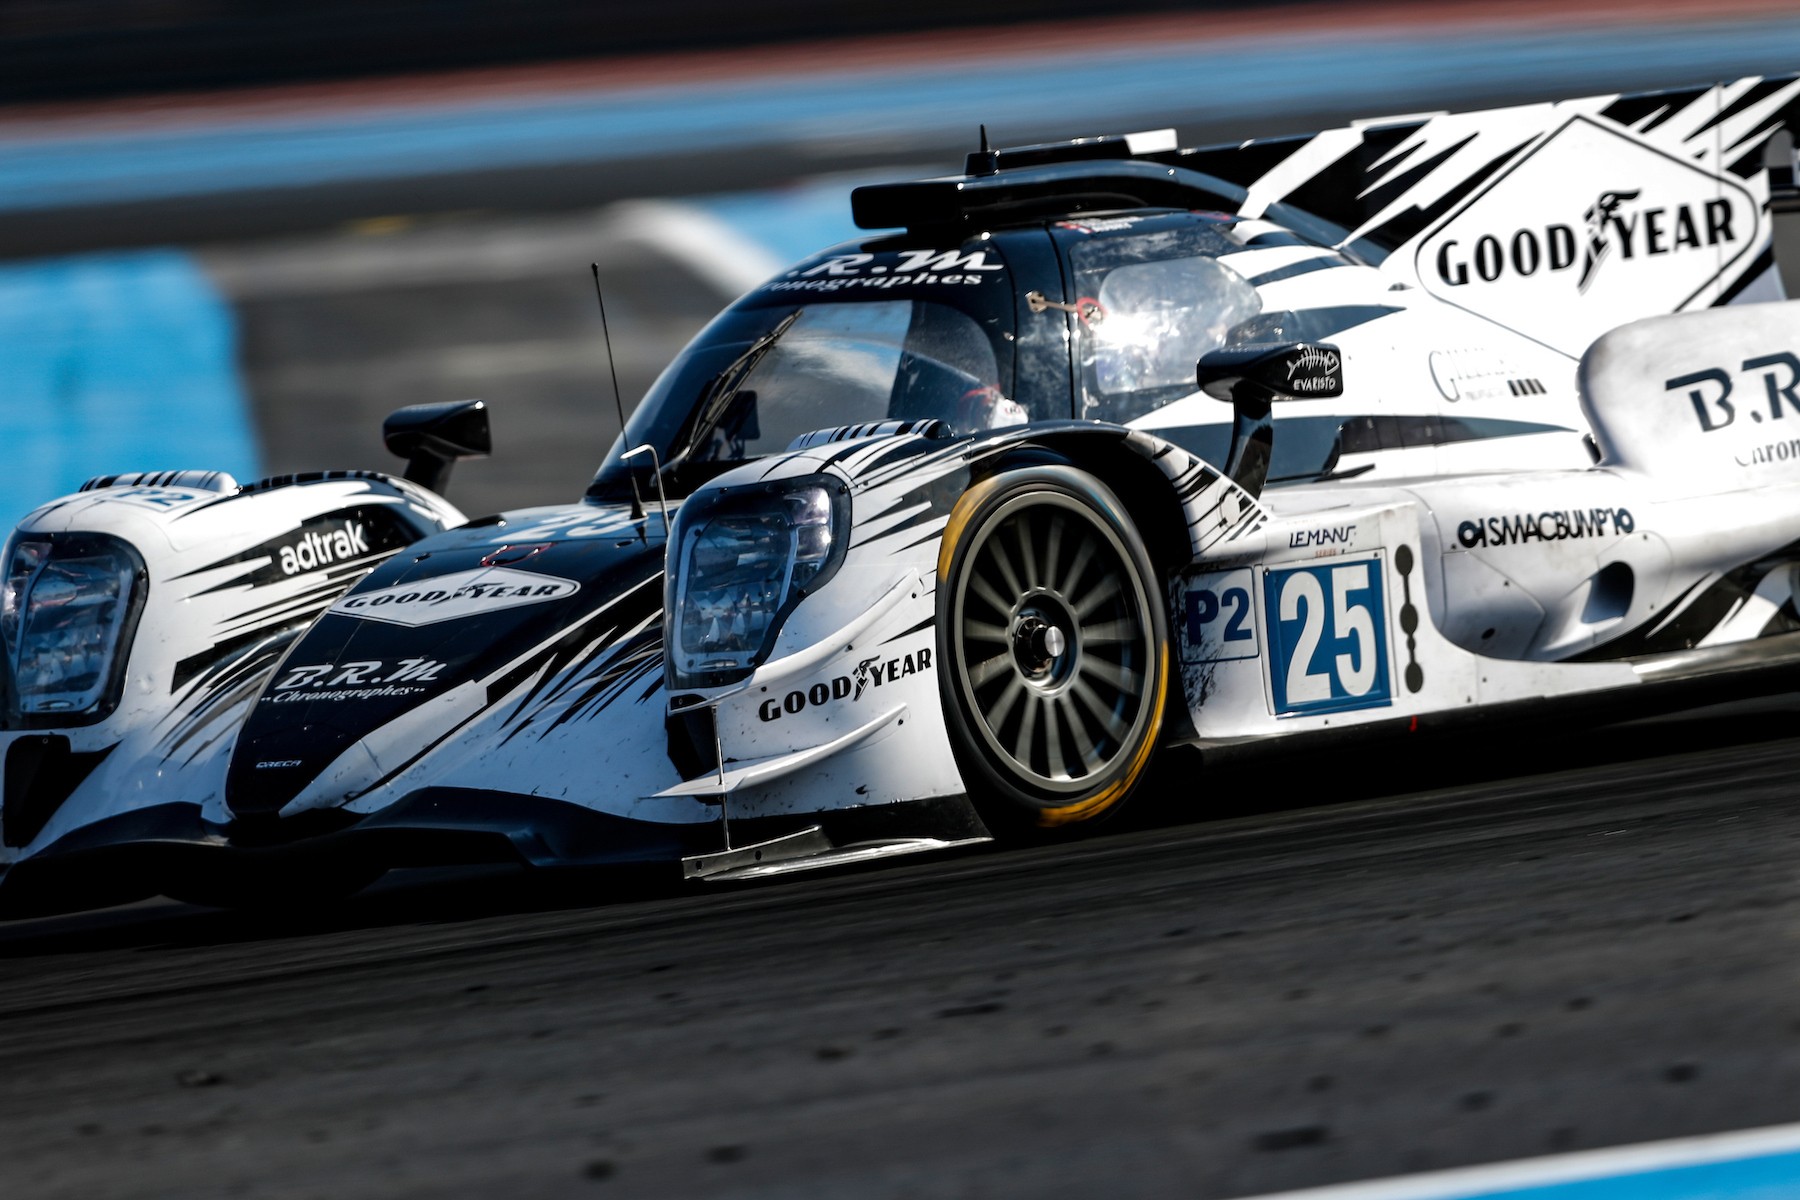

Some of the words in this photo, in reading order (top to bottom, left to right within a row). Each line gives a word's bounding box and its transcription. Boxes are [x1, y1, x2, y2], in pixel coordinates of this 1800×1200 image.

[1293, 376, 1336, 391] EVARISTO
[279, 519, 370, 575] adtrak
[1185, 587, 1253, 646] P2
[1279, 564, 1377, 705] 25
